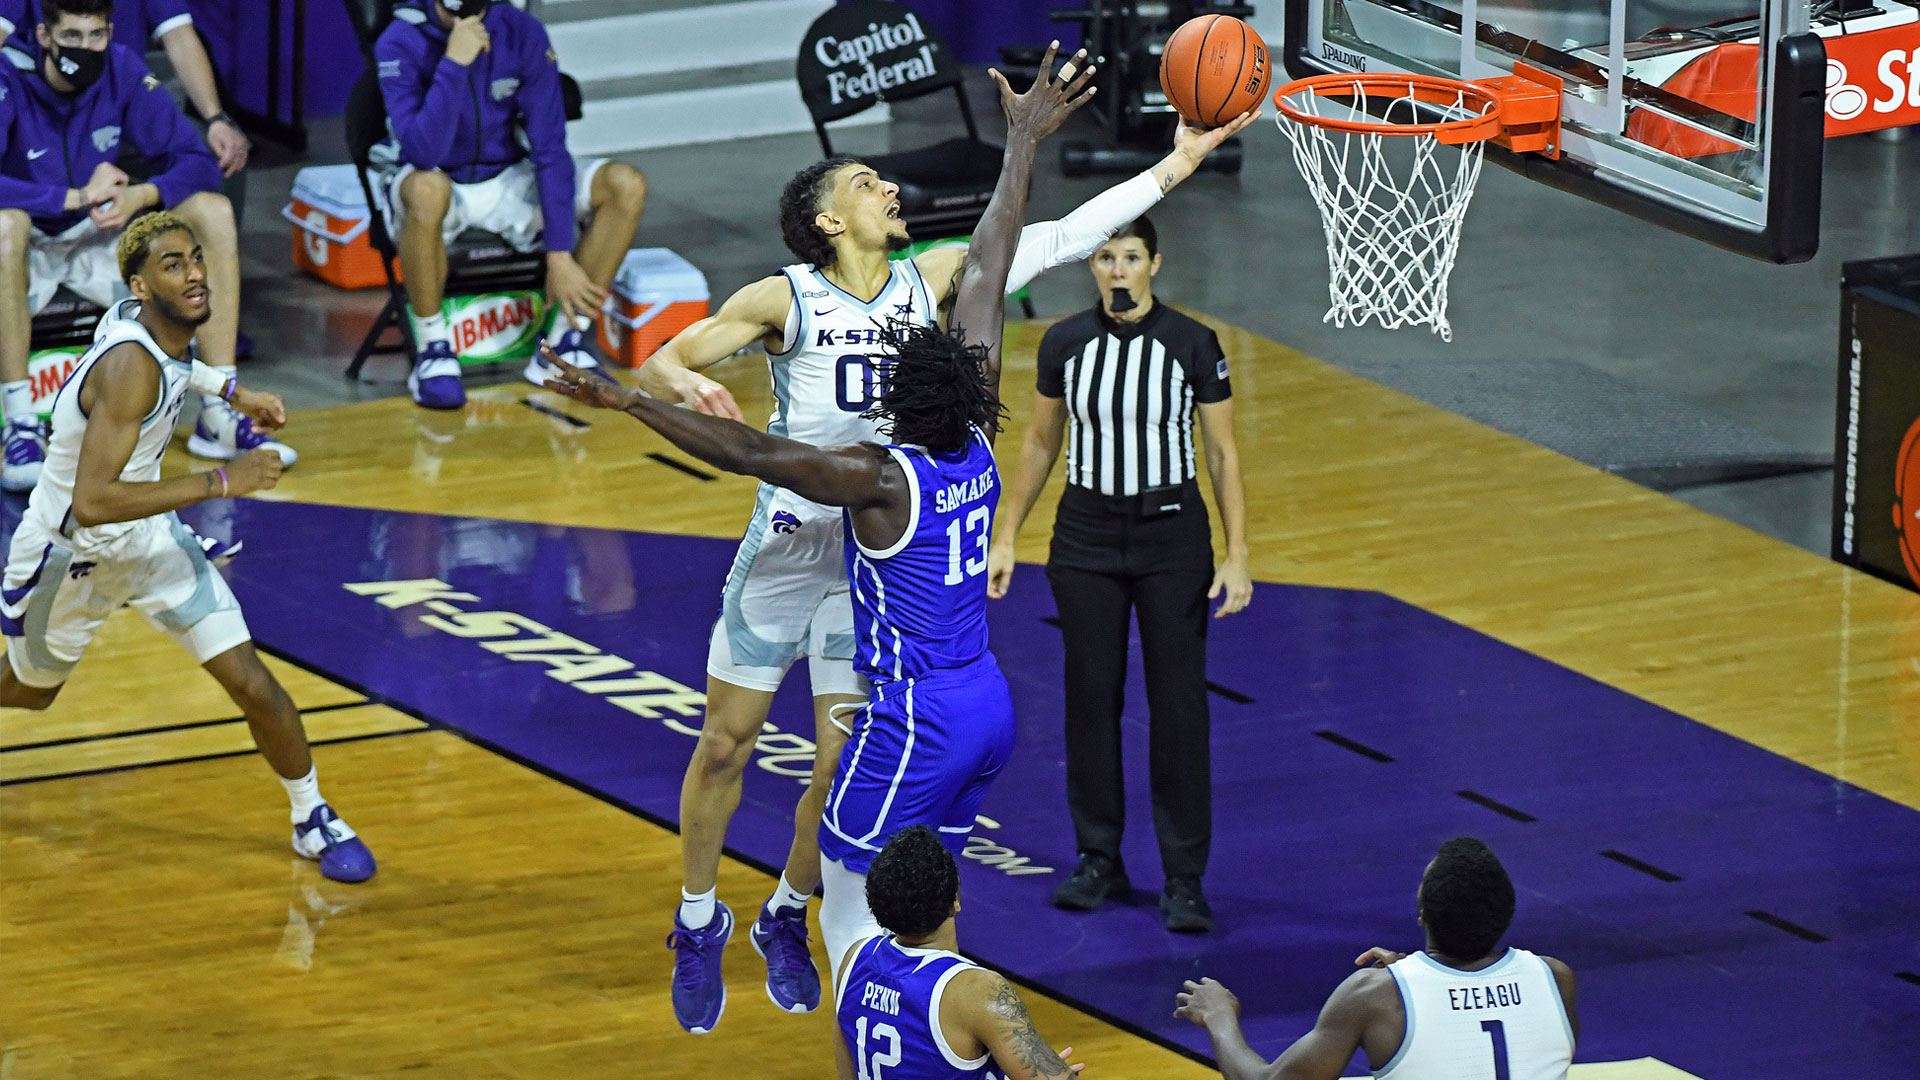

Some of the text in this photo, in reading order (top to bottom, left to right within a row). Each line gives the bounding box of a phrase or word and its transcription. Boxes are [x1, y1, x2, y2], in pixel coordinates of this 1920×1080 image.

[815, 12, 926, 68] Capitol
[1322, 42, 1366, 73] SPALDING
[826, 45, 937, 105] Federal
[452, 298, 533, 351] IBMAN
[816, 328, 908, 347] K-ST
[935, 465, 994, 513] SAMAKE
[944, 504, 990, 586] 13
[861, 981, 901, 1016] PENN
[1448, 982, 1521, 1010] EZEAGU
[855, 1016, 902, 1080] 12
[1480, 1019, 1511, 1080] 1
